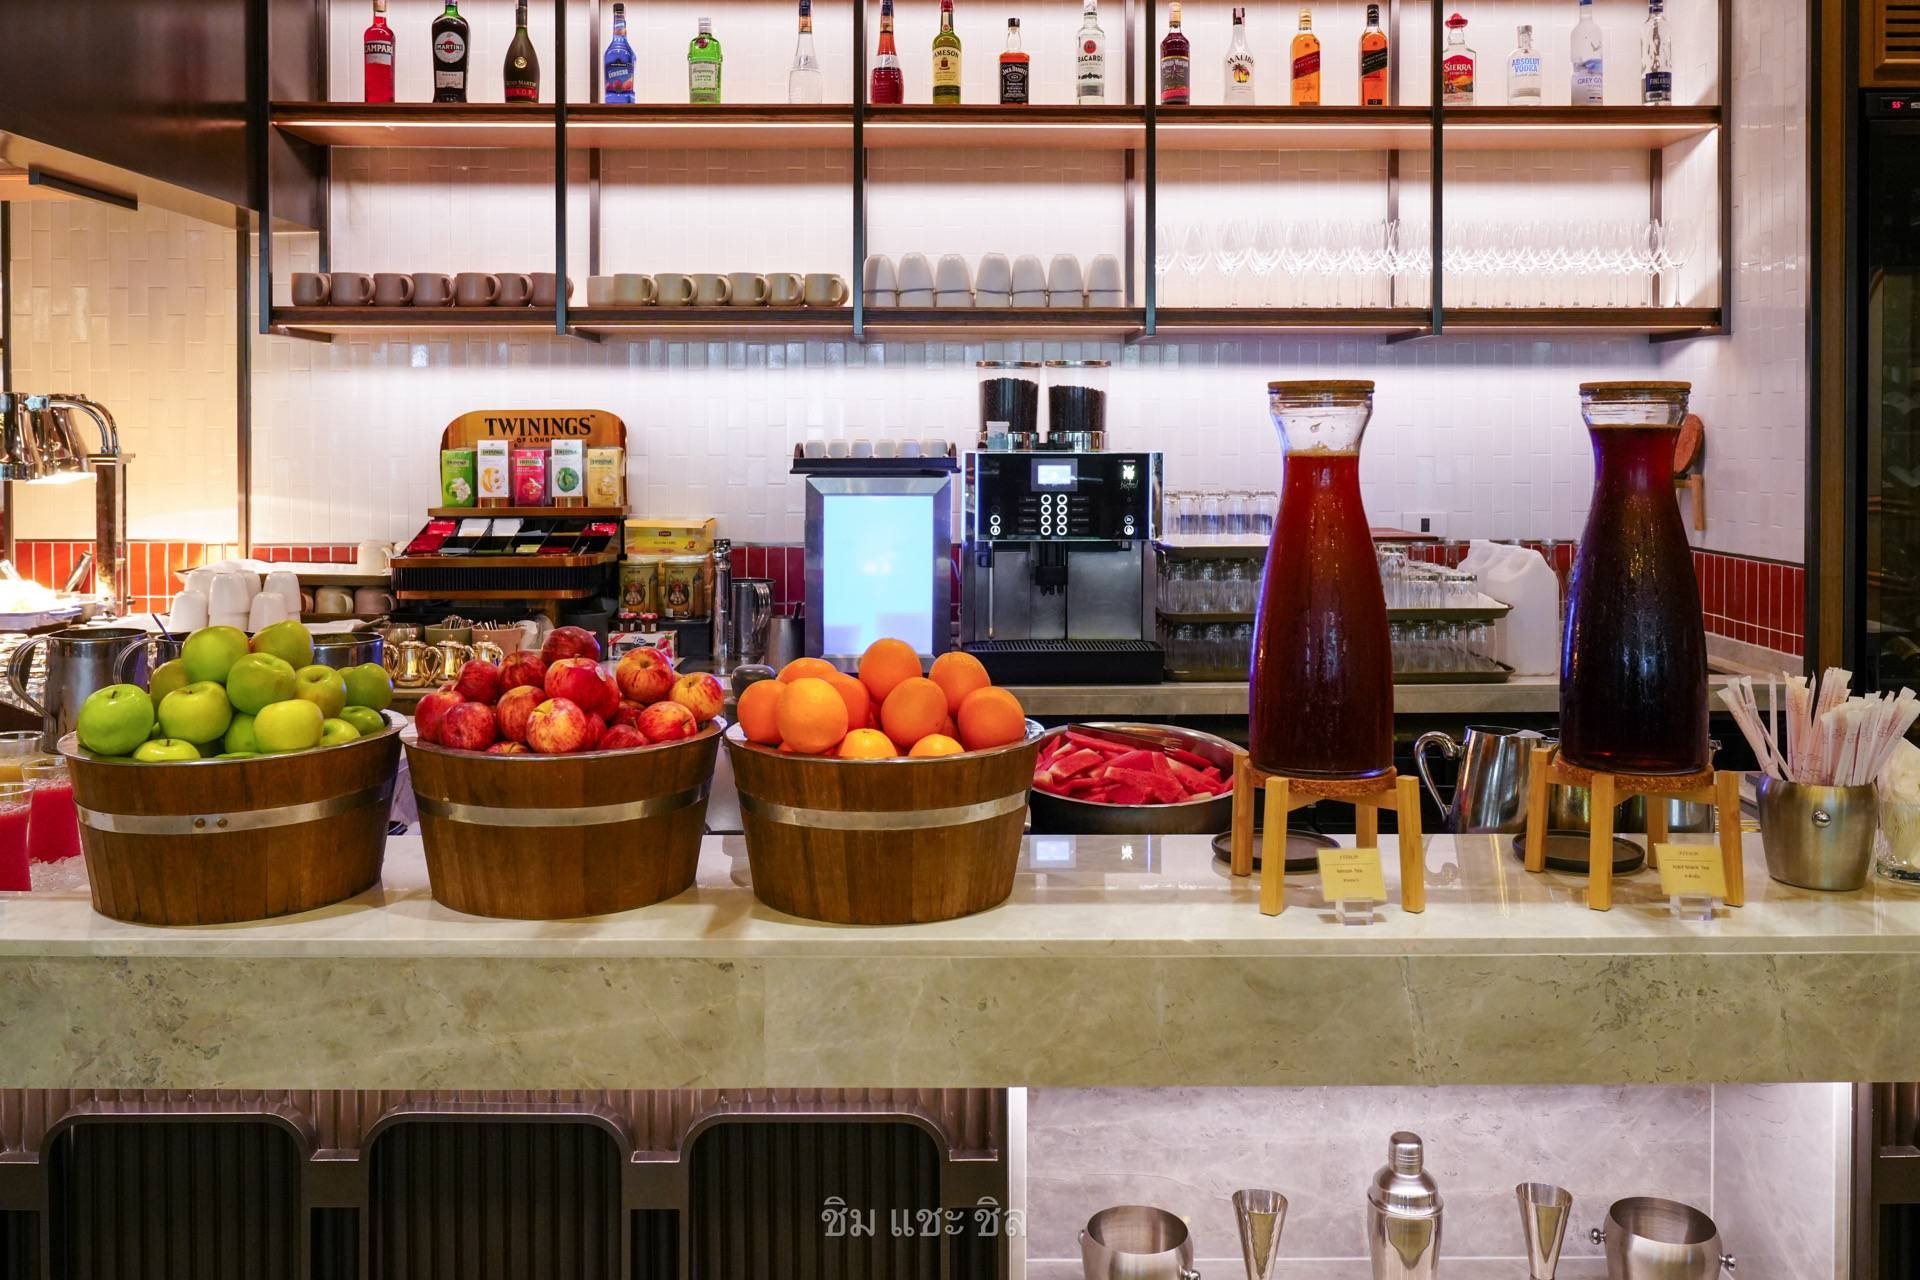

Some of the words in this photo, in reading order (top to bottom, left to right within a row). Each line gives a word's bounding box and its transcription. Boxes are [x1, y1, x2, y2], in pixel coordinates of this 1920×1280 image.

[437, 43, 463, 51] MARTINI
[1511, 57, 1540, 66] ABSOLUT
[1444, 63, 1472, 72] SIERRA
[1514, 65, 1538, 73] VODKA
[485, 417, 592, 436] TWININGS
